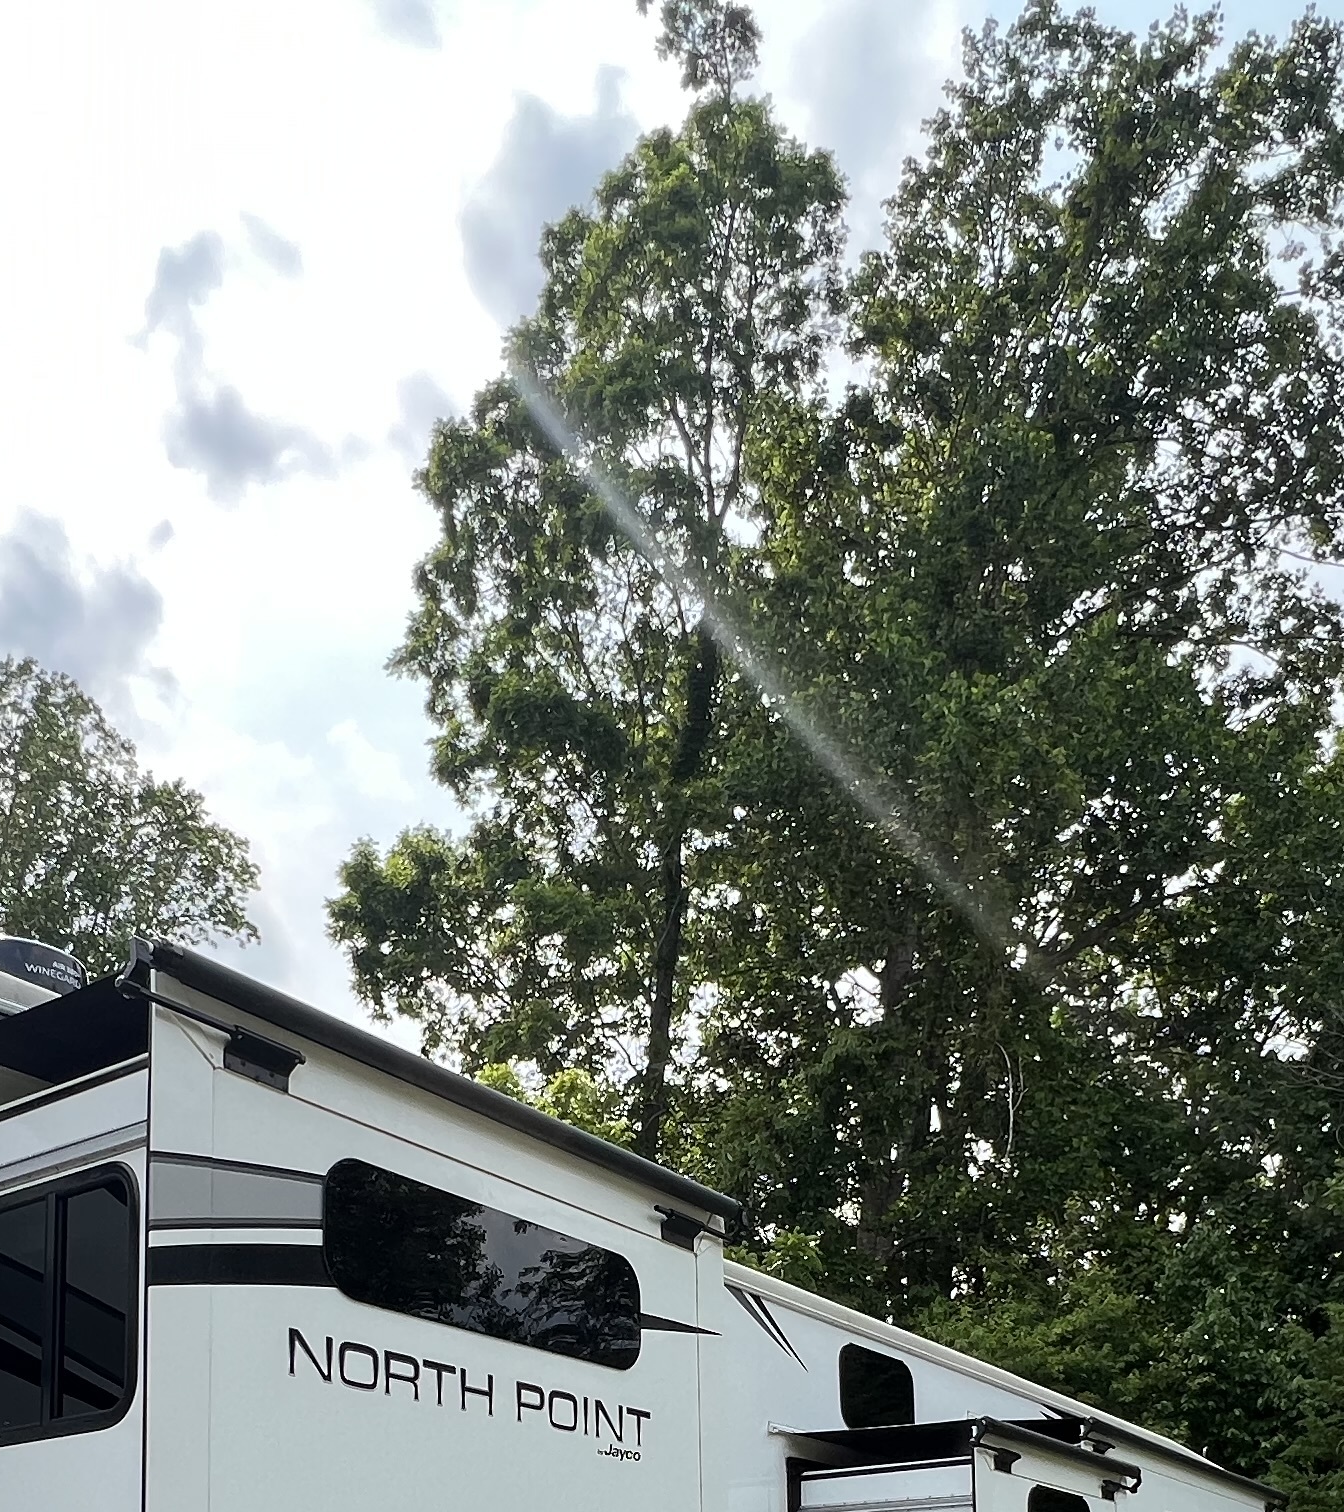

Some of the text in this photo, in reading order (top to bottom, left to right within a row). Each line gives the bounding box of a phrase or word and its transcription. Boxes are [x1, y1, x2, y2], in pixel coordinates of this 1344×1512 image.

[288, 1327, 652, 1447] NORTH POINT
[604, 1443, 642, 1461] Jayco
